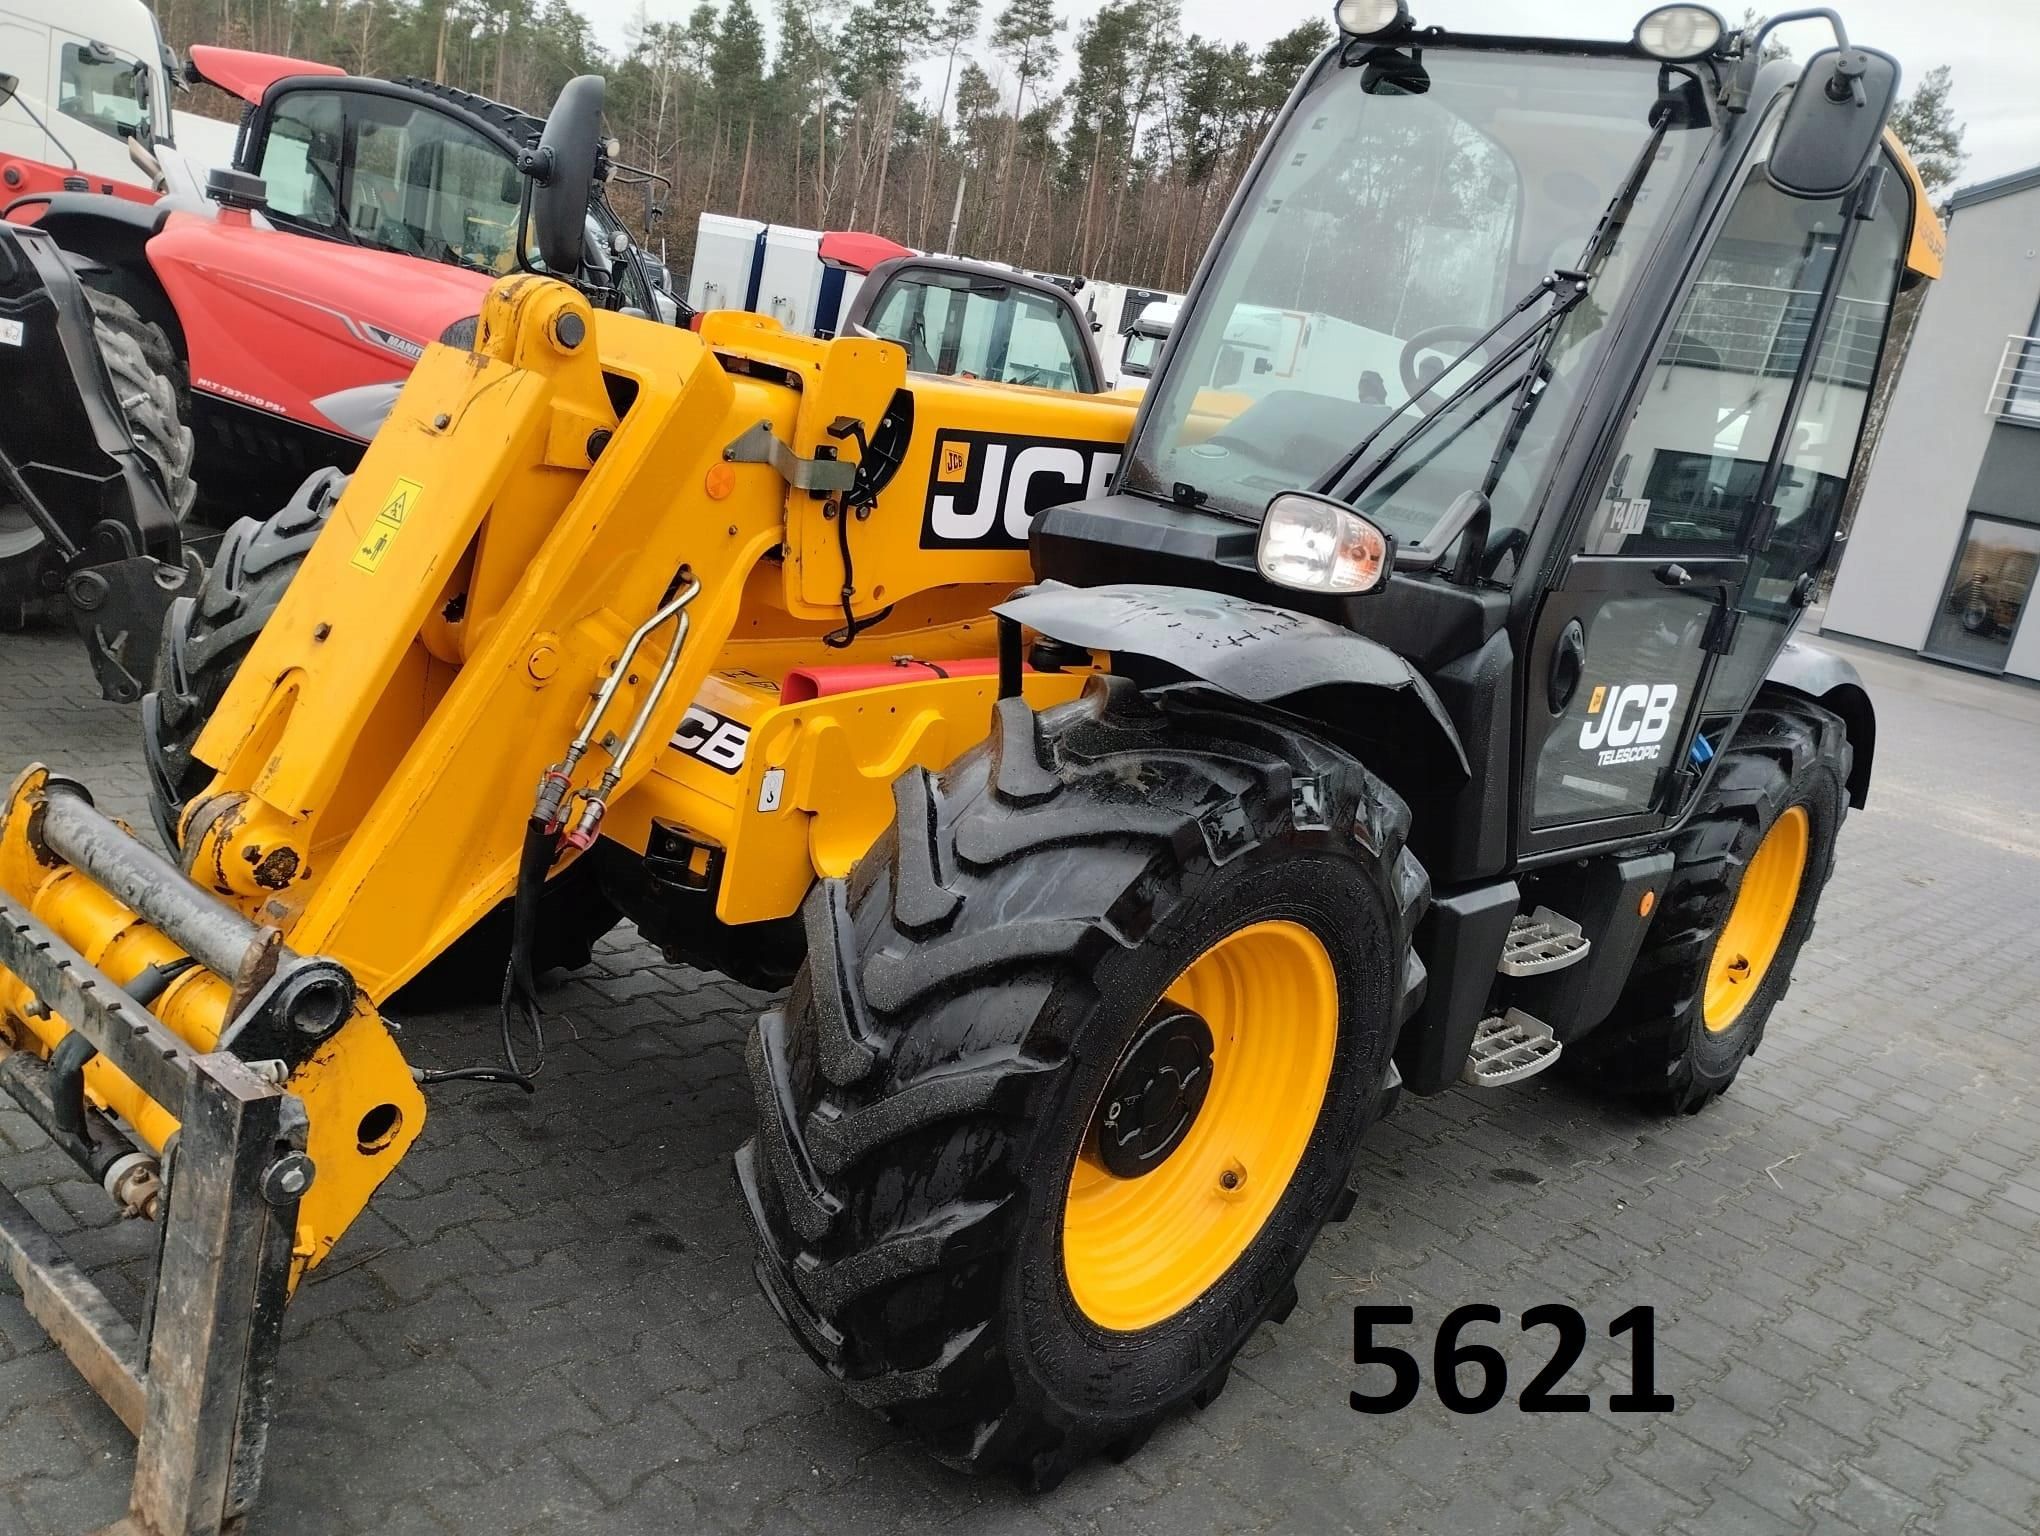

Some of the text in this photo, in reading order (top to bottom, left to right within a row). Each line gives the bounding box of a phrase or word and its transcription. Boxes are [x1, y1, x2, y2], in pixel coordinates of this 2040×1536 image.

[197, 377, 220, 391] MLT
[946, 451, 964, 472] JCB
[931, 443, 1122, 540] JC
[1578, 684, 1678, 750] JCB
[1597, 744, 1661, 767] TELESCOPIC
